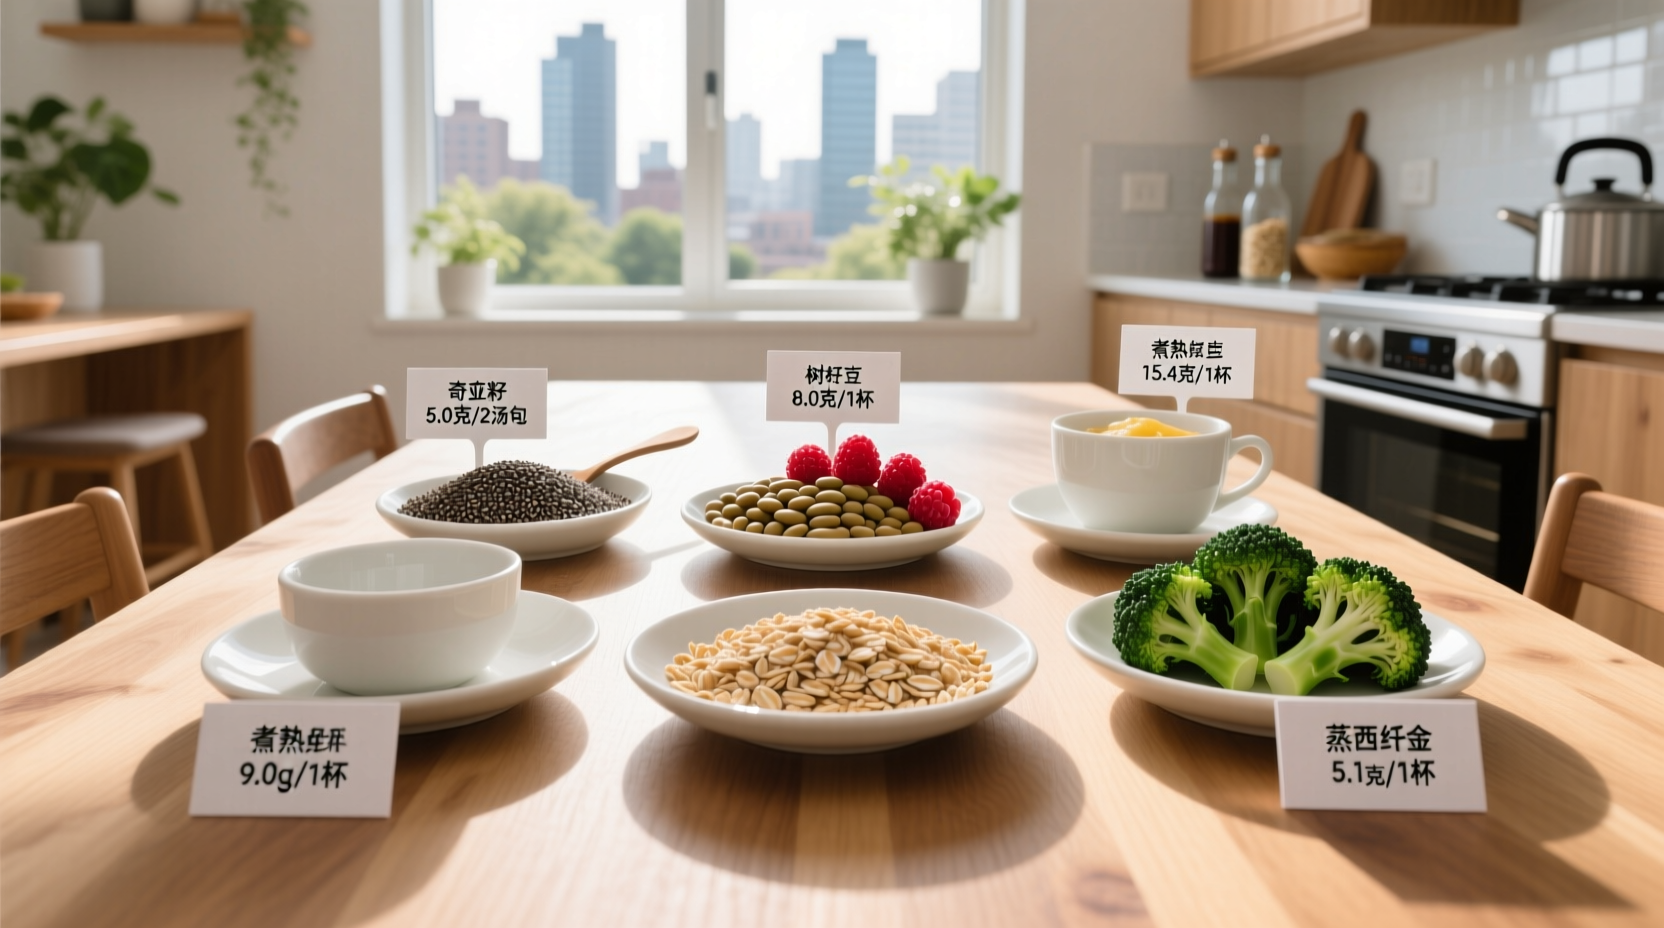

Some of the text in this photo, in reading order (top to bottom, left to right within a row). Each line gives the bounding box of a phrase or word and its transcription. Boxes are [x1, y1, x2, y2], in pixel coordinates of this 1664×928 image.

[1142, 363, 1232, 385] 15.4克/1杯
[792, 387, 875, 409] 8.0克/1杯
[1325, 723, 1432, 753] 蒸西纤金
[239, 759, 349, 793] 9.0g/1杯
[1332, 758, 1436, 789] 5.1克/1杯
